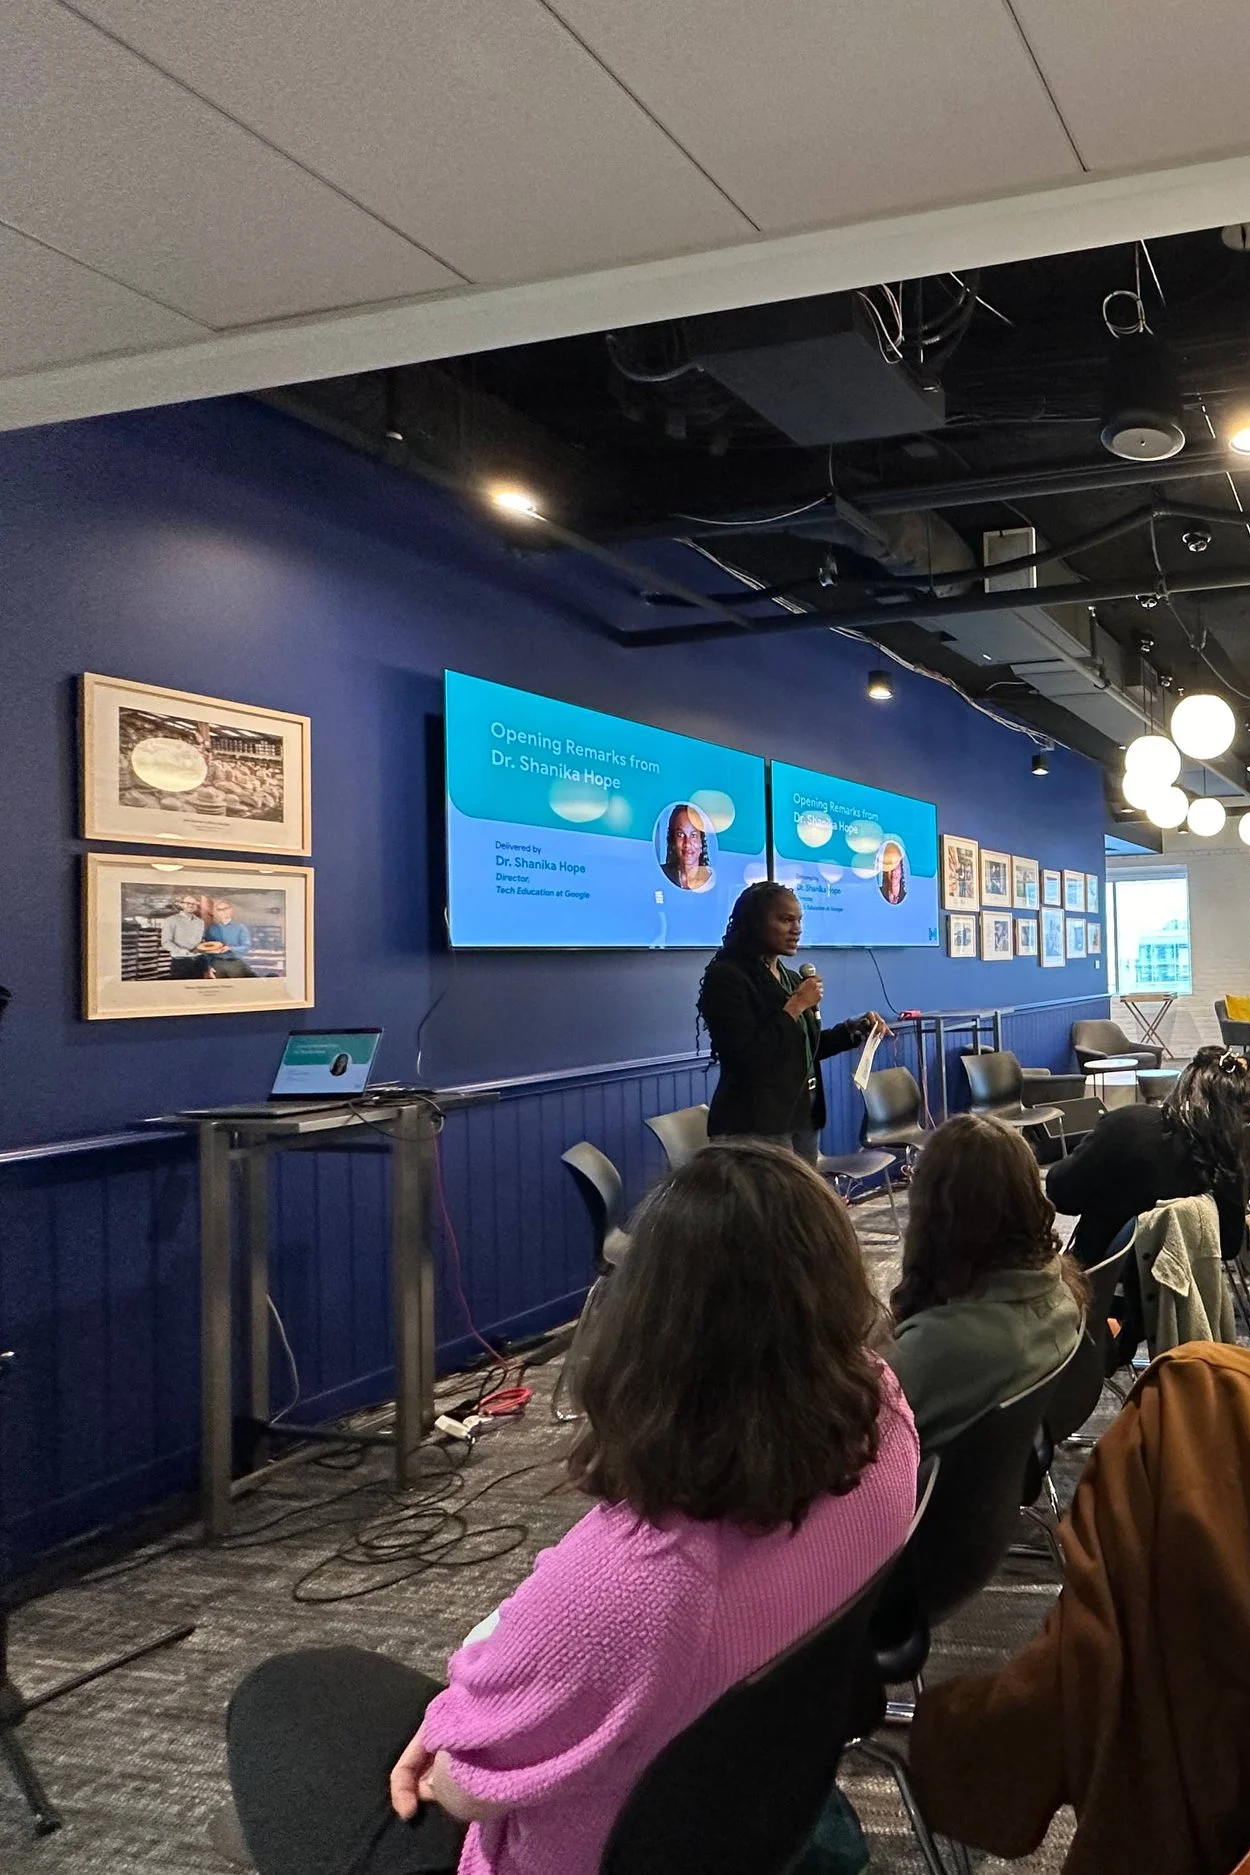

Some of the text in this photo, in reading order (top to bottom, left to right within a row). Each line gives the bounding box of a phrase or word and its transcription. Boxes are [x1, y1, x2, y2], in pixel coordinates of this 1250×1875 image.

[491, 722, 660, 774] Opening Remarks from
[491, 749, 621, 790] Dr. Shanika Hope
[793, 793, 878, 821] Opening Remarks from
[794, 812, 805, 824] Dr.
[839, 821, 859, 835] Hope
[495, 841, 542, 855] Delivered by
[496, 855, 586, 875] Dr. Shanika Hope
[496, 885, 515, 895] Tech
[517, 887, 555, 897] Education
[564, 890, 590, 900] Google
